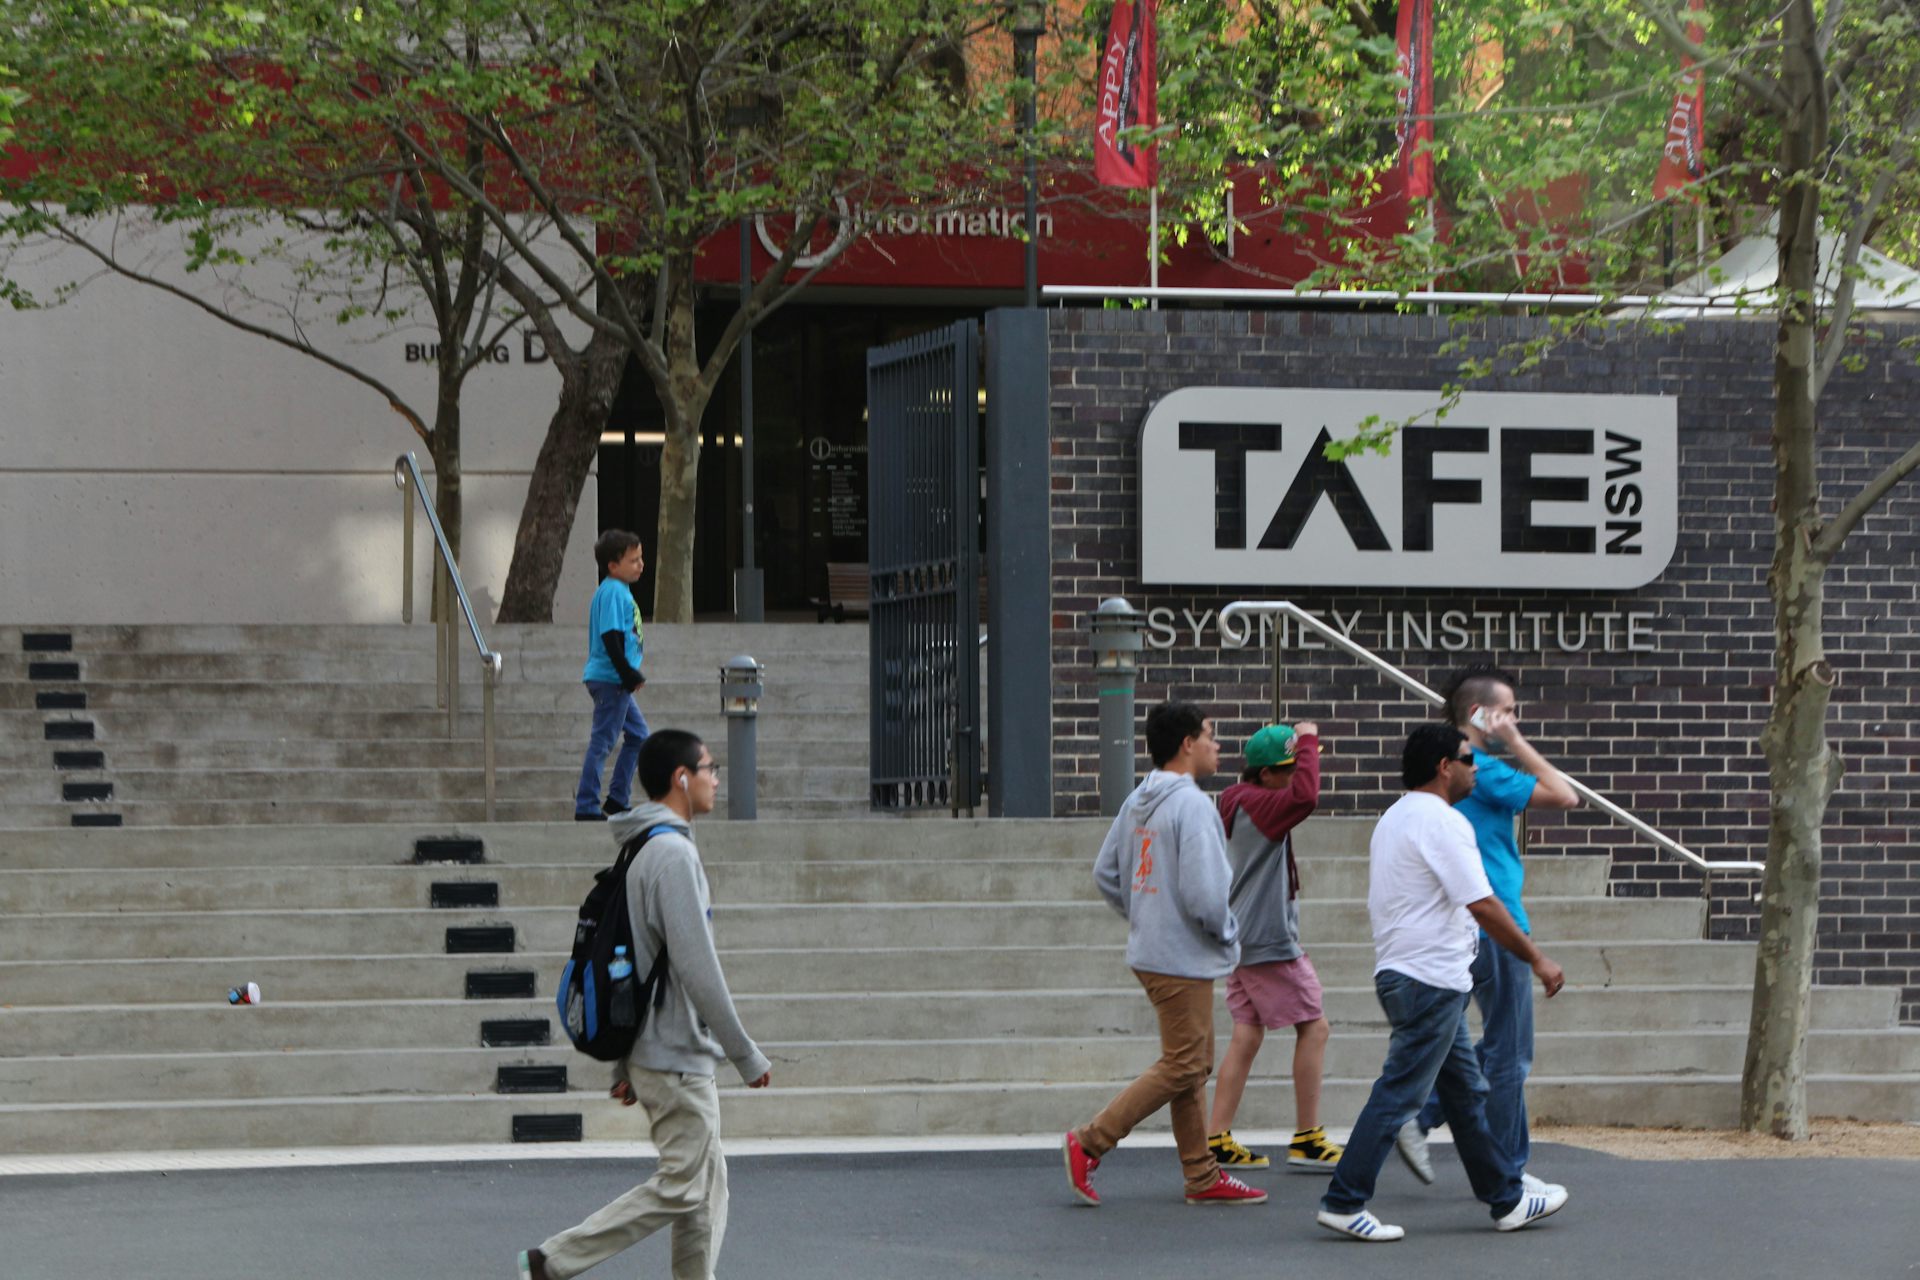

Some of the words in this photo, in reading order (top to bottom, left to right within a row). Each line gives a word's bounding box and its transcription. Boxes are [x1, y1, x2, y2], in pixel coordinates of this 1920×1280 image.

[405, 343, 510, 363] BUING
[523, 329, 549, 364] D
[1178, 421, 1597, 554] TAFE
[1604, 430, 1643, 555] NSW
[1147, 607, 1362, 649] SYDNEY
[1386, 609, 1656, 653] INSTITUTE
